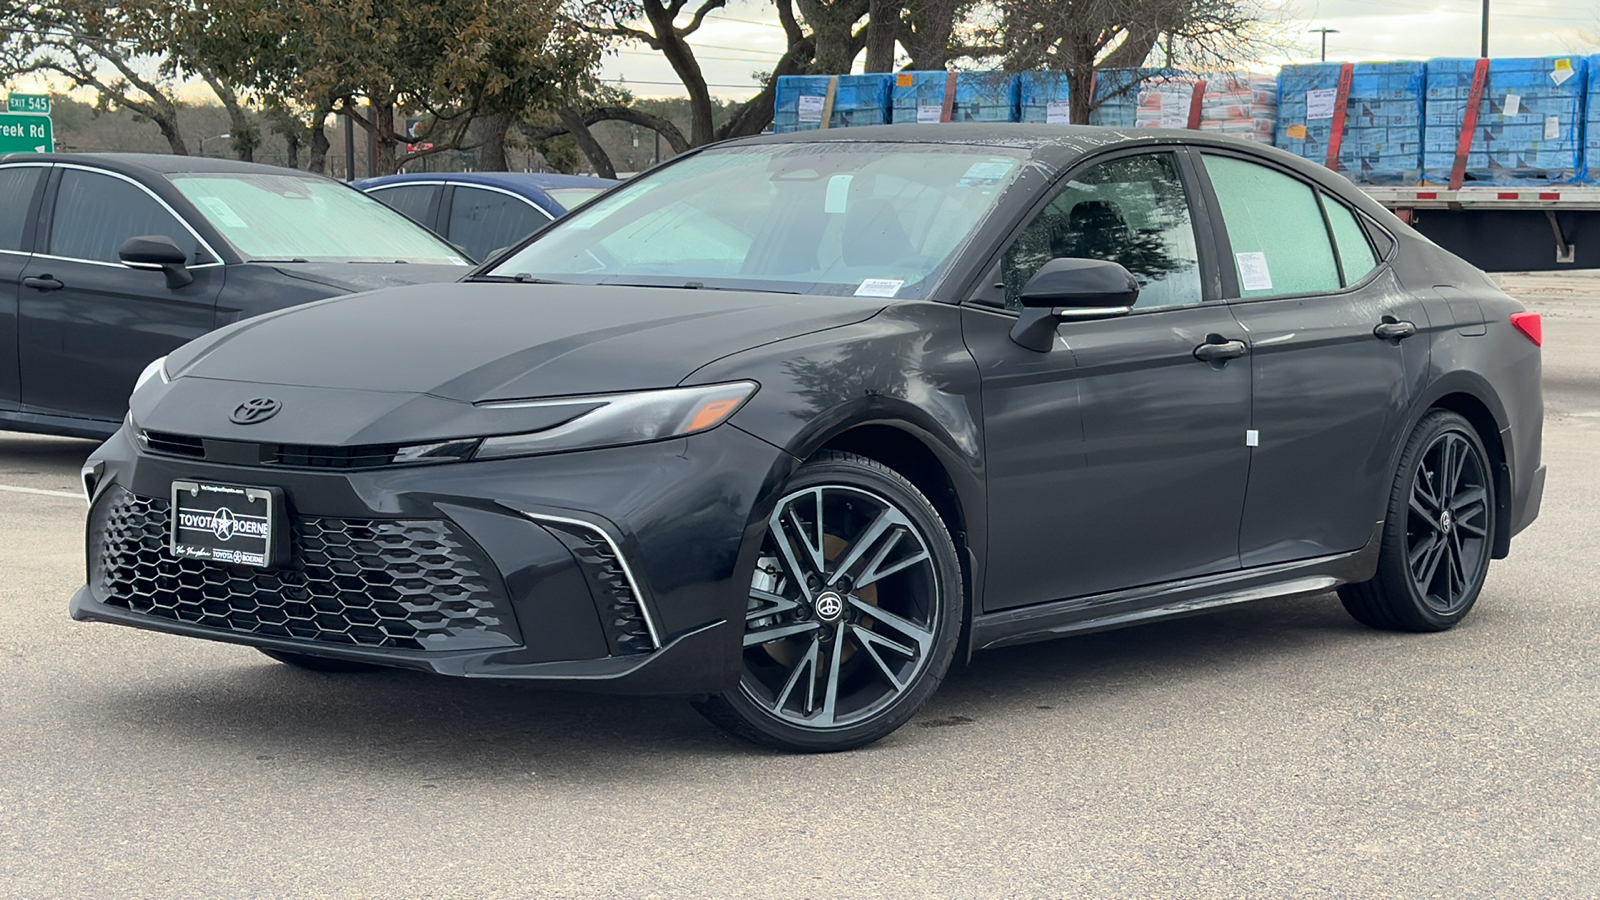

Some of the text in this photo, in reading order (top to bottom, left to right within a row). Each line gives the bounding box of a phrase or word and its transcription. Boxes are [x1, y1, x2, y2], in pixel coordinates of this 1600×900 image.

[10, 97, 47, 110] EXIT 545
[30, 124, 45, 138] Rd
[179, 513, 267, 535] TOYOTA BOERNE
